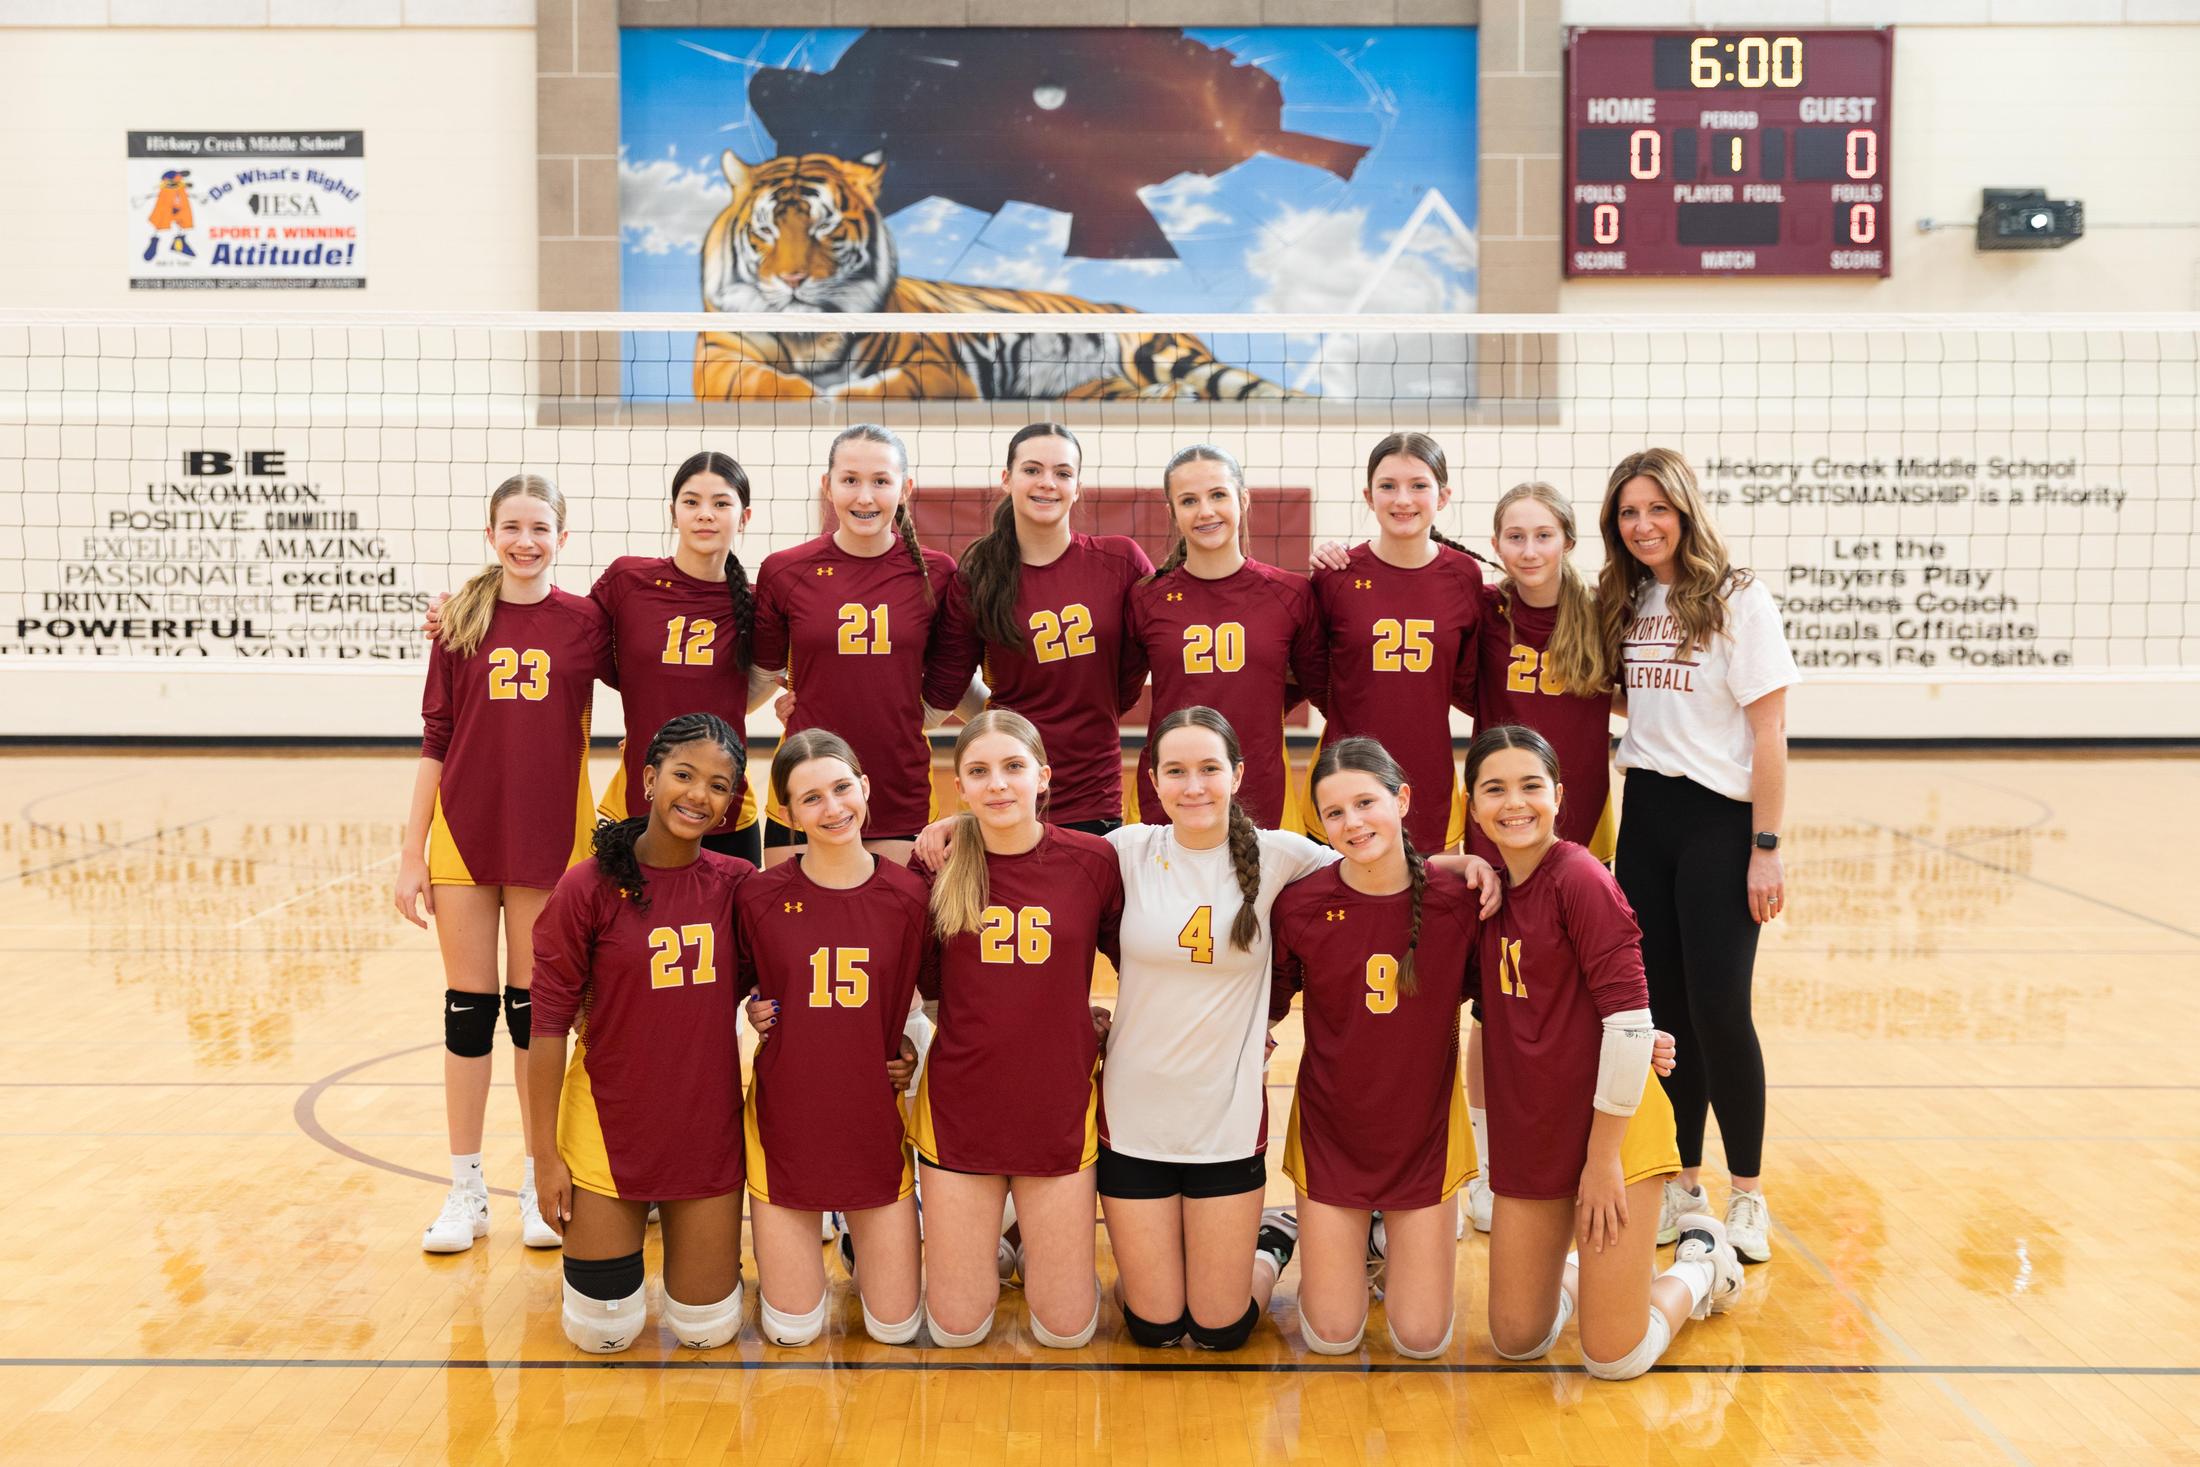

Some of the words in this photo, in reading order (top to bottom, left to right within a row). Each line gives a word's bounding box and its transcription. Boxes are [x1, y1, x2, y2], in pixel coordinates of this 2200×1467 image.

[1690, 37, 1803, 88] 6:00
[1587, 98, 1656, 123] HOME
[1700, 110, 1759, 130] PERIOD
[1799, 97, 1877, 123] GUEST
[146, 136, 200, 154] Hickory
[203, 136, 247, 151] Creek
[250, 136, 297, 151] Middle
[300, 136, 345, 151] School
[1630, 129, 1661, 180] 0
[1731, 136, 1742, 172] 1
[1846, 129, 1877, 180] 0
[209, 183, 232, 201] Do
[236, 168, 300, 185] What's
[306, 168, 360, 202] Right!
[1574, 185, 1626, 203] FOULS
[1674, 185, 1734, 203] PLAYER
[1743, 185, 1785, 203] FOUL
[1831, 185, 1883, 203] FOULS
[262, 194, 321, 216] IESA
[208, 226, 260, 239] SPORT
[267, 226, 277, 239] A
[283, 226, 357, 239] WINNING
[1594, 204, 1619, 244] 0
[1850, 204, 1876, 244] 0
[211, 243, 356, 265] Attitude!
[1574, 251, 1627, 270] SCORE
[1700, 251, 1755, 270] MATCH
[1830, 251, 1883, 270] SCORE
[183, 450, 286, 476] BE
[1705, 458, 1800, 484] Hickory
[1812, 458, 1888, 479] Creek
[1897, 458, 1977, 479] Middle
[1988, 457, 2077, 479] School
[1741, 485, 1969, 505] SPORTSMANSHIP
[1980, 486, 1998, 504] is
[2010, 488, 2024, 504] a
[2034, 485, 2127, 512] Priority
[1833, 540, 1880, 560] Let
[1895, 540, 1945, 560] the
[1789, 565, 1906, 591] Players
[1924, 566, 1993, 591] Play
[1914, 592, 2019, 614] Coach
[661, 615, 717, 666] 12
[838, 603, 892, 655] 21
[1029, 603, 1096, 664] 22
[1784, 619, 1879, 640] ficials
[1894, 619, 2037, 641] Officiate
[1183, 622, 1246, 674] 20
[1372, 618, 1435, 673] 25
[1790, 648, 1882, 668] tators
[489, 647, 551, 701] 23
[980, 905, 1052, 965] 26
[1178, 905, 1214, 965] 4
[648, 922, 717, 990] 27
[1499, 936, 1529, 999] 11
[809, 947, 870, 1008] 15
[1365, 953, 1399, 1015] 9
